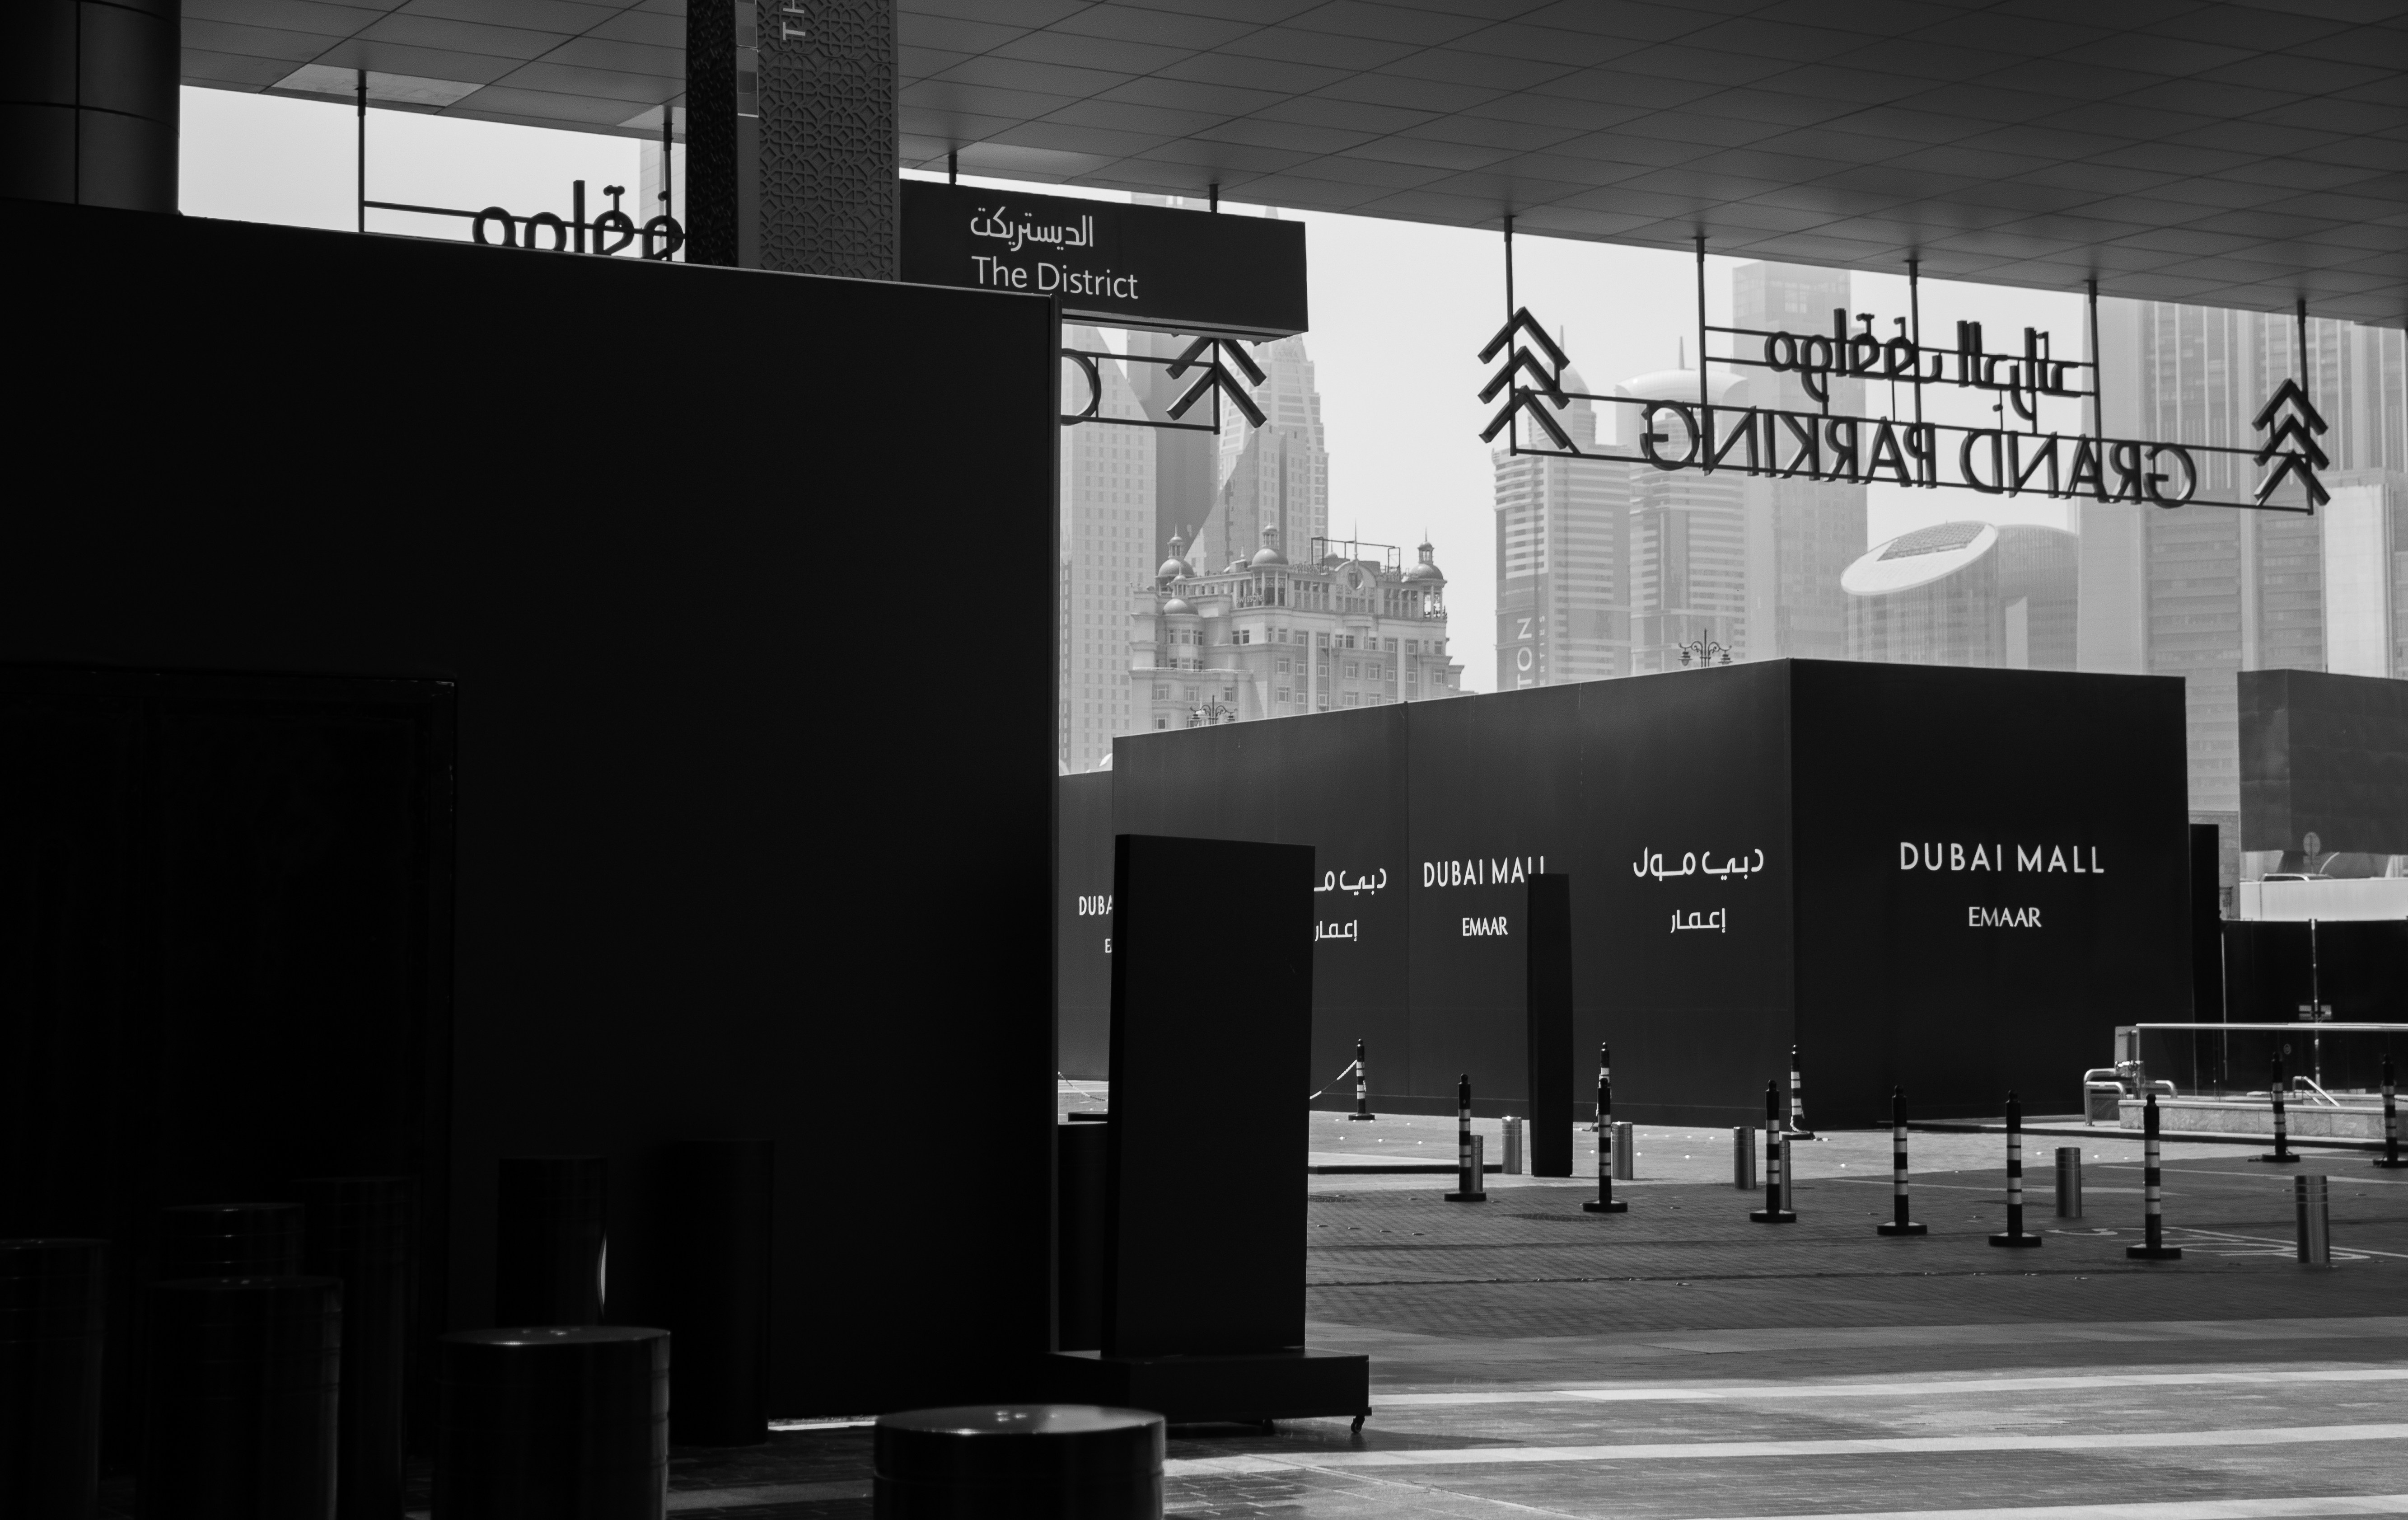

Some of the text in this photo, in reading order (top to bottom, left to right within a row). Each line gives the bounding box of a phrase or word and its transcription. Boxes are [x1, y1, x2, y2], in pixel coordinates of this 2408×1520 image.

[970, 206, 1093, 252] الديستريكت
[971, 255, 1138, 299] The District
[1632, 846, 1764, 882] دبي مول
[1900, 842, 2105, 873] DUBAI MALL
[1339, 868, 1387, 896] دبي
[1423, 858, 1483, 887] DUBAI
[1079, 895, 1113, 916] DUBA
[1968, 906, 2043, 928] EMAAR
[1314, 919, 1358, 942] إعمار
[1462, 916, 1509, 937] EMAAR
[1670, 907, 1726, 934] إعمار
